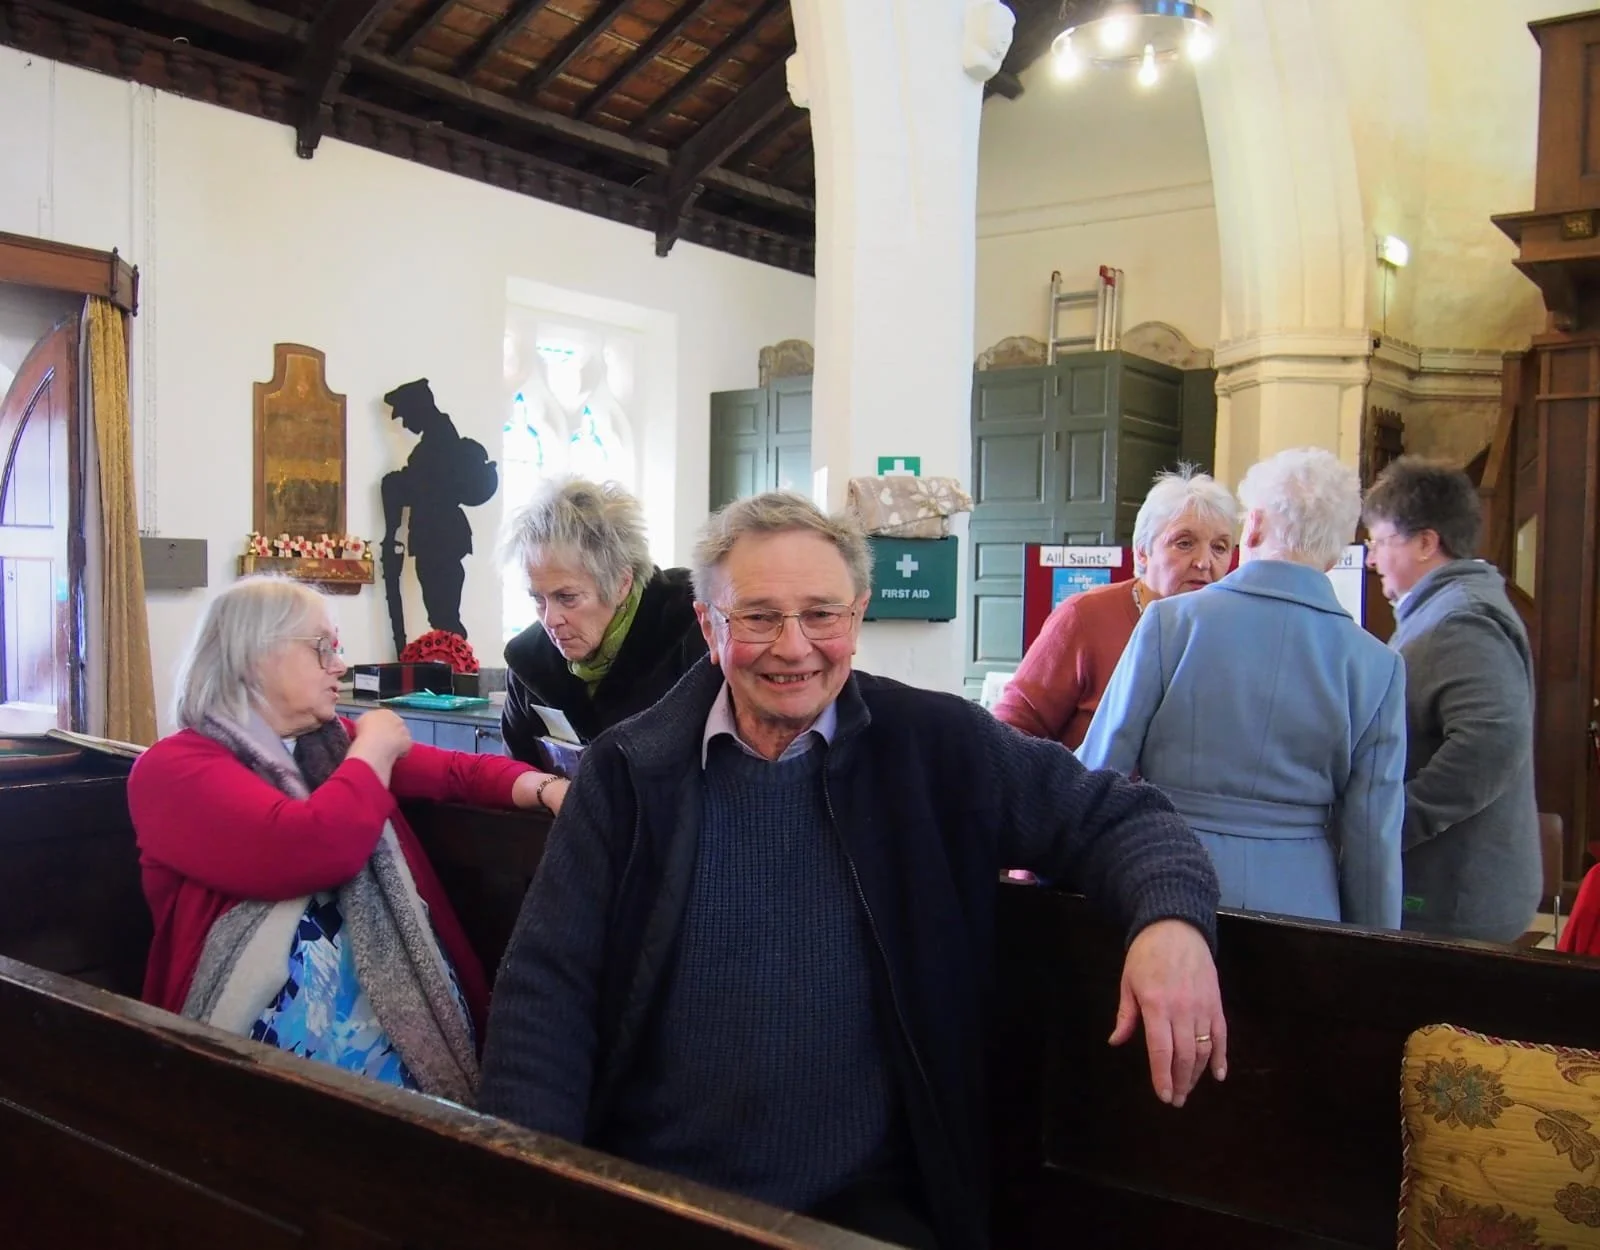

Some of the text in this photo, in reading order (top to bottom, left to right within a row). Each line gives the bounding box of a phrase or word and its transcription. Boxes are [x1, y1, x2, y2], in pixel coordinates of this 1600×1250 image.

[1046, 552, 1061, 564] All
[881, 588, 931, 599] FIRST AID
